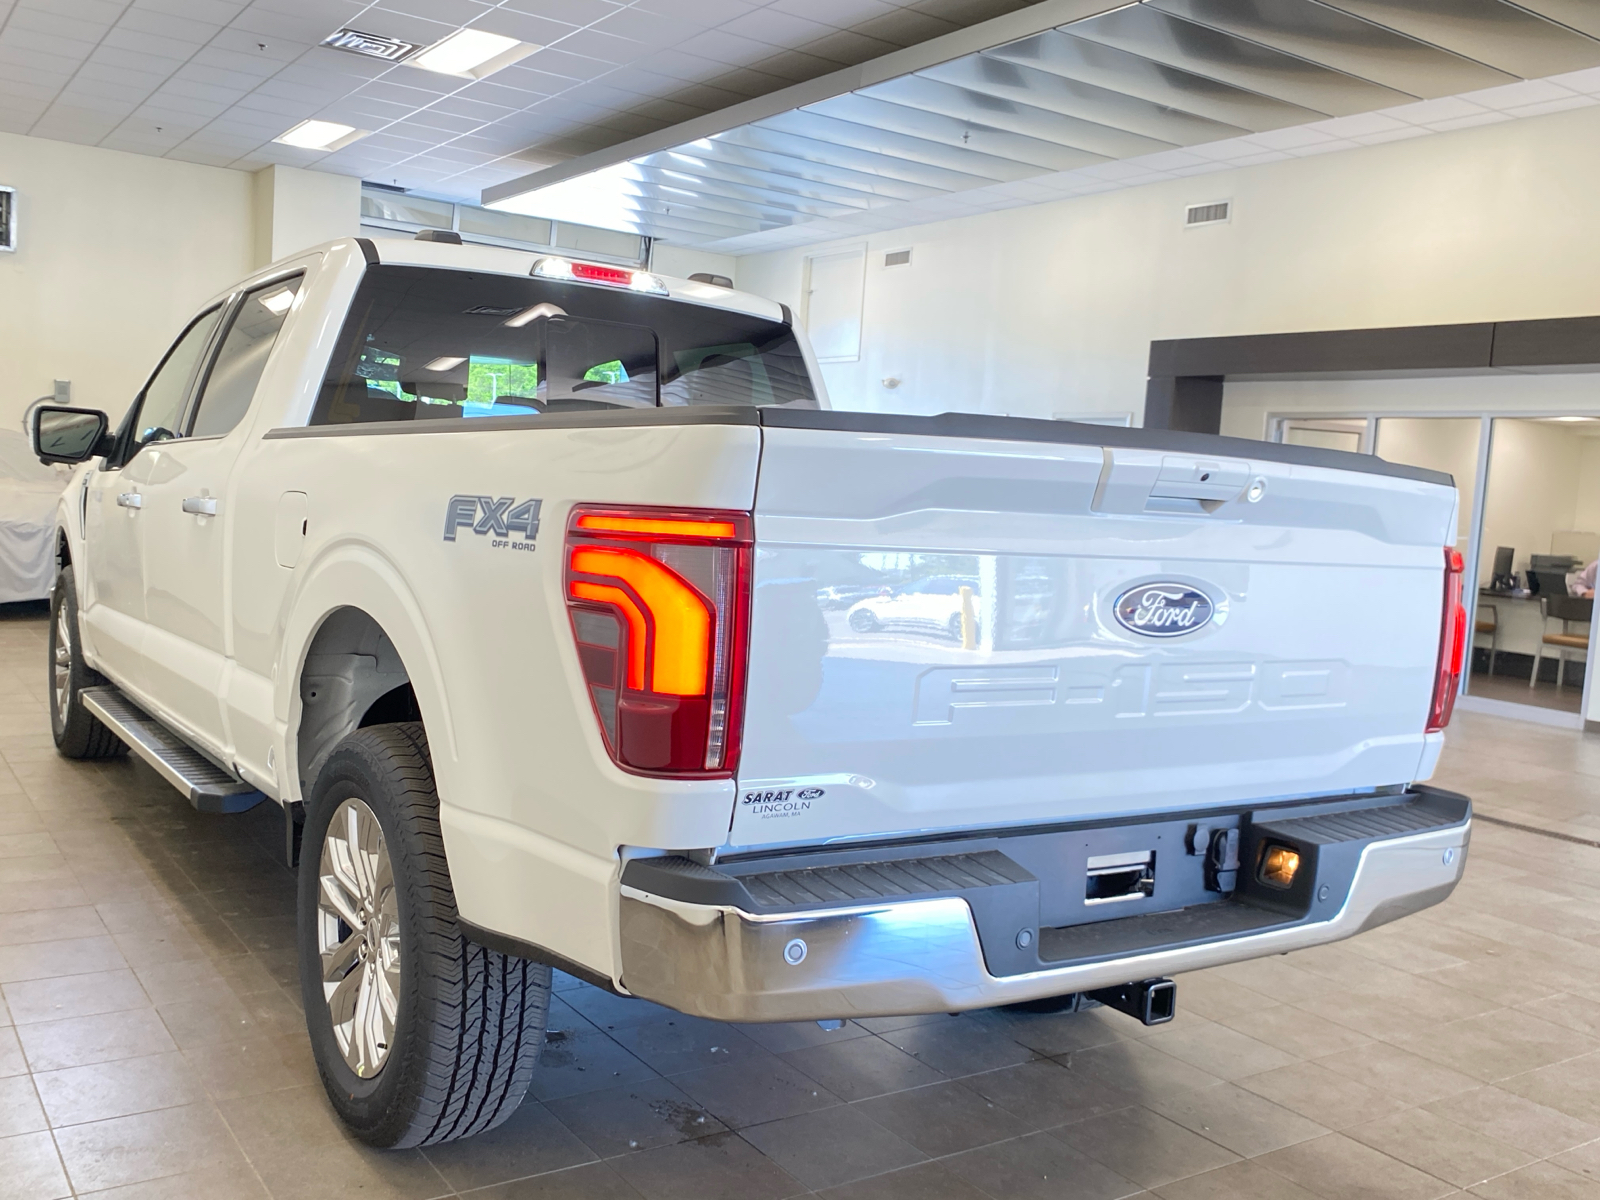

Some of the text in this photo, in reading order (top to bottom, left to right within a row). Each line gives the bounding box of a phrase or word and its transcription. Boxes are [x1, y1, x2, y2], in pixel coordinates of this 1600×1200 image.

[443, 494, 543, 542] FX4
[492, 540, 536, 552] OFF ROAD
[1134, 590, 1198, 626] Ford
[912, 658, 1350, 726] F-150
[743, 790, 794, 804] SARAT
[752, 801, 811, 814] LINCOLN
